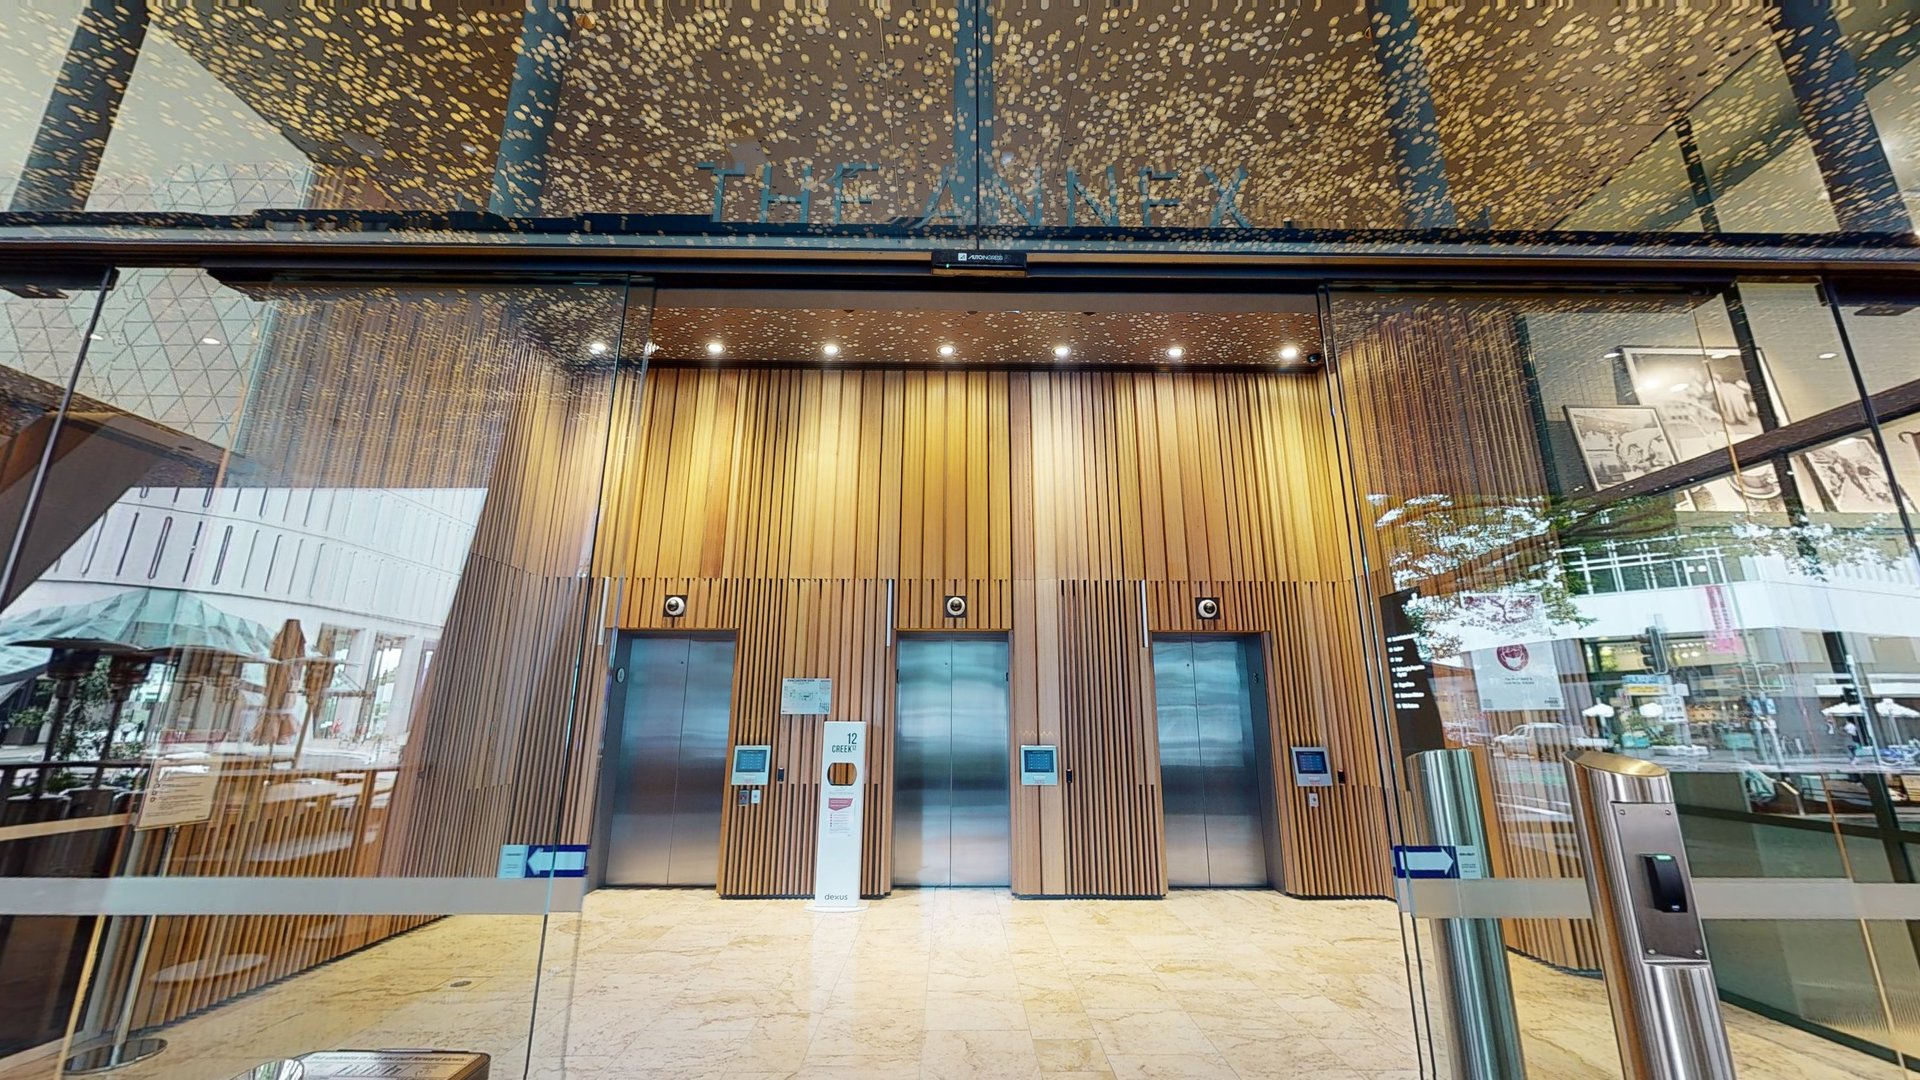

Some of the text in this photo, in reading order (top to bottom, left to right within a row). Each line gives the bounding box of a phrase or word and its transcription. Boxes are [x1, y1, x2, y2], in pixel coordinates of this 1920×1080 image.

[698, 162, 1252, 228] THE ANNEX
[847, 732, 858, 745] 12
[831, 744, 852, 753] CREEK
[824, 893, 848, 901] dexus
